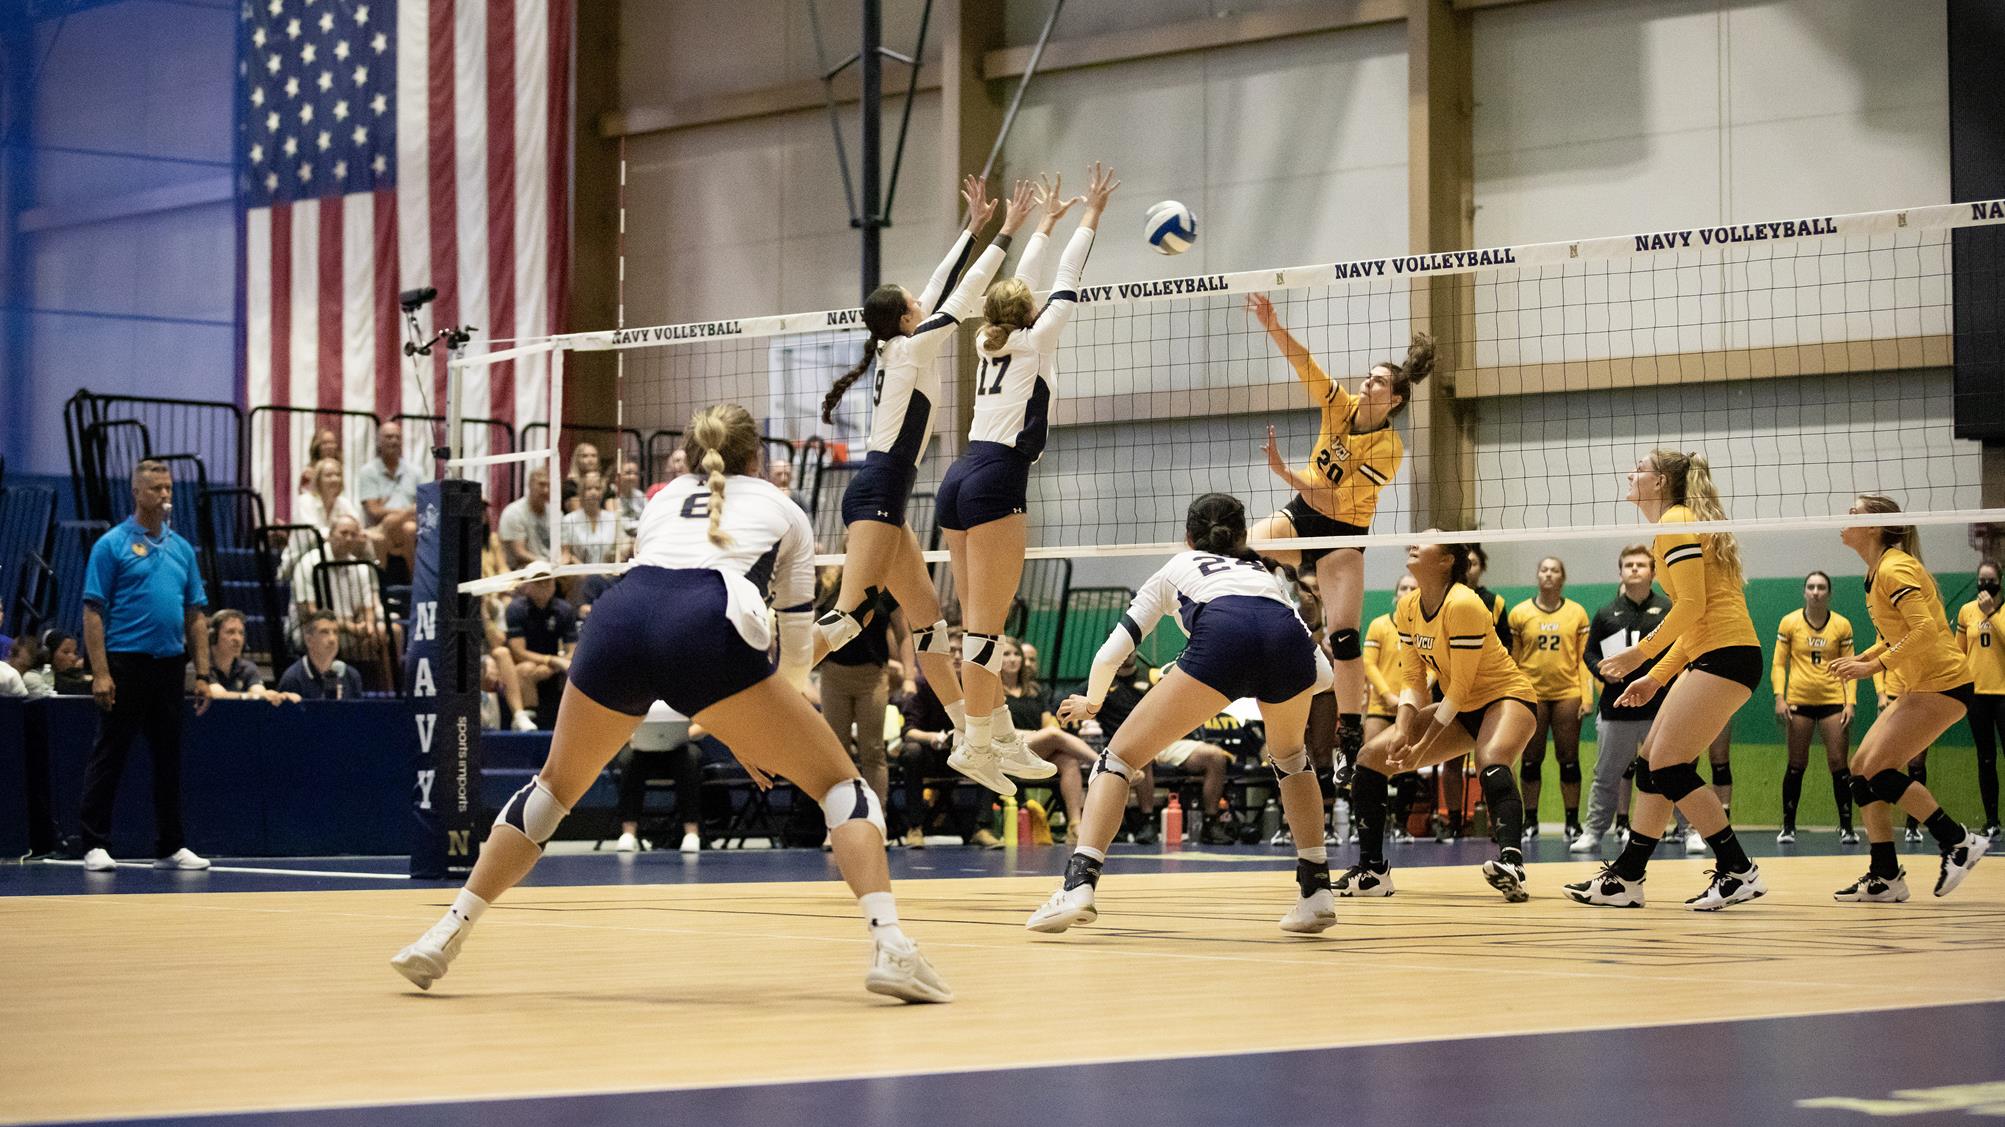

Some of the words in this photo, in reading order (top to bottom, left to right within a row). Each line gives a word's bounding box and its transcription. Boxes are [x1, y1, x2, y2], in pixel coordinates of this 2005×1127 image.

[1971, 202, 2005, 220] NA
[1635, 231, 1692, 252] NAVY
[1699, 217, 1837, 245] VOLLEYBALL
[1335, 260, 1386, 279] NAVY
[1392, 248, 1515, 273] VOLLEYBALL
[1079, 286, 1113, 303] AVY
[1119, 275, 1228, 299] VOLLEYBALL
[654, 321, 742, 341] VOLLEYBALL
[978, 354, 1012, 395] 17
[1316, 449, 1344, 484] 20
[1415, 634, 1435, 650] VCU
[1538, 635, 1560, 651] 22
[1808, 637, 1827, 647] VCU
[1980, 633, 1991, 648] 0
[414, 601, 437, 809] NAVY
[457, 715, 468, 757] sports
[456, 760, 468, 813] imports
[447, 830, 471, 857] N
